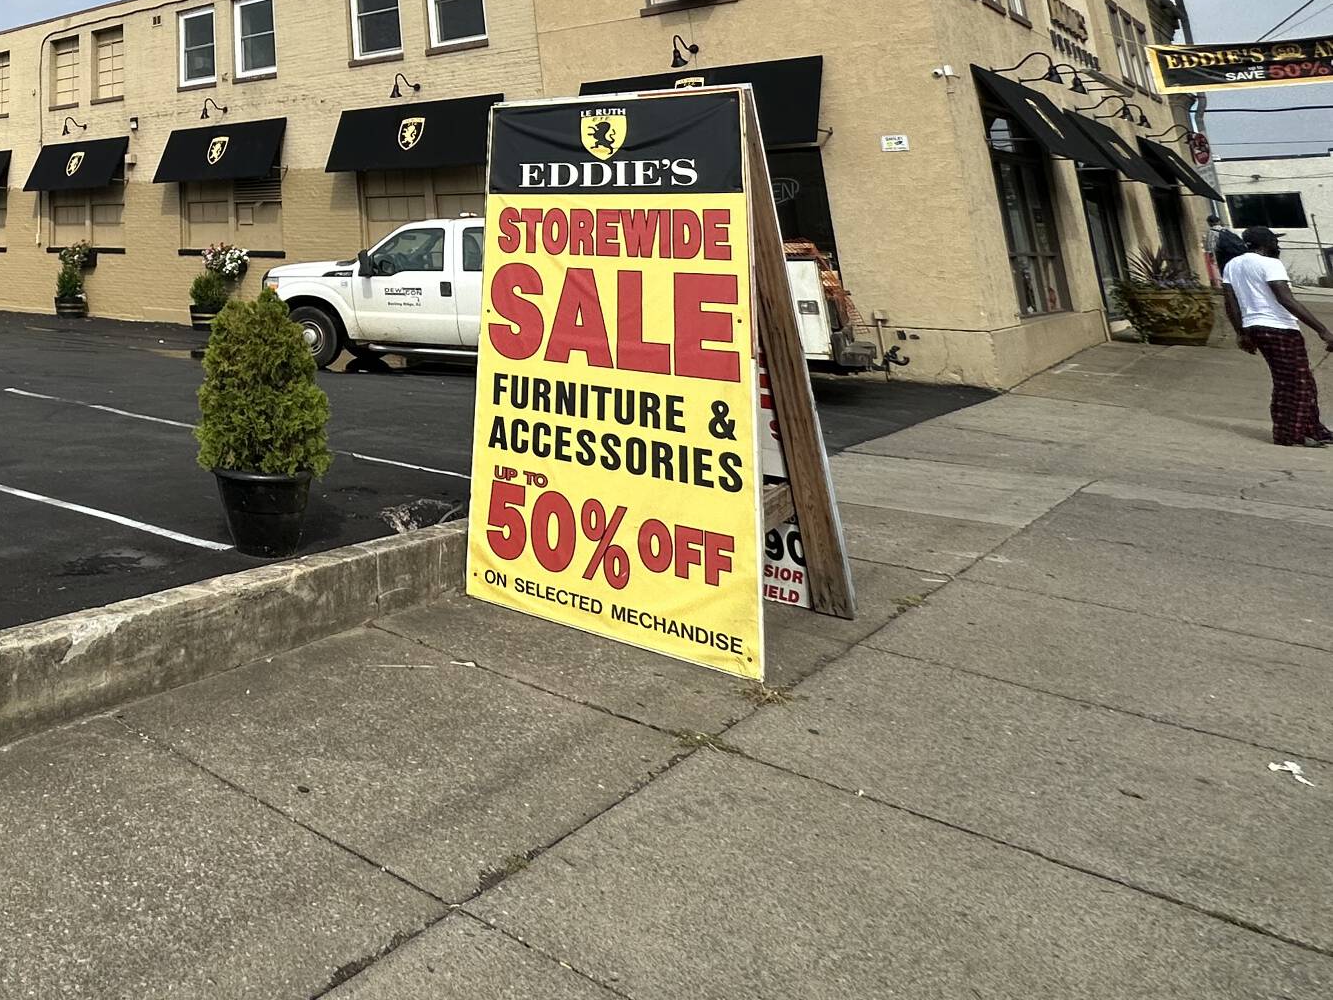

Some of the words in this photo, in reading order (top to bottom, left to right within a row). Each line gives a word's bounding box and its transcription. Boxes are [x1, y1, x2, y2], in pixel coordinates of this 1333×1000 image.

[1164, 47, 1265, 70] EDDIE'S
[1225, 70, 1265, 82] SAVE
[1268, 60, 1329, 79] 50%
[580, 110, 592, 118] LE
[595, 107, 626, 116] RUTH
[518, 158, 698, 188] EDDIE'S
[497, 207, 732, 260] STOREWIDE
[488, 262, 741, 382] SALE
[493, 373, 686, 433] FURNITURE
[708, 400, 737, 441] &
[488, 416, 743, 493] ACCESSORIES
[494, 465, 517, 481] UP
[523, 470, 548, 488] TO
[486, 480, 630, 590] 50%
[638, 518, 734, 586] OFF
[484, 569, 507, 588] ON
[514, 578, 603, 615] SELECTED
[611, 605, 743, 655] MECHANDISE
